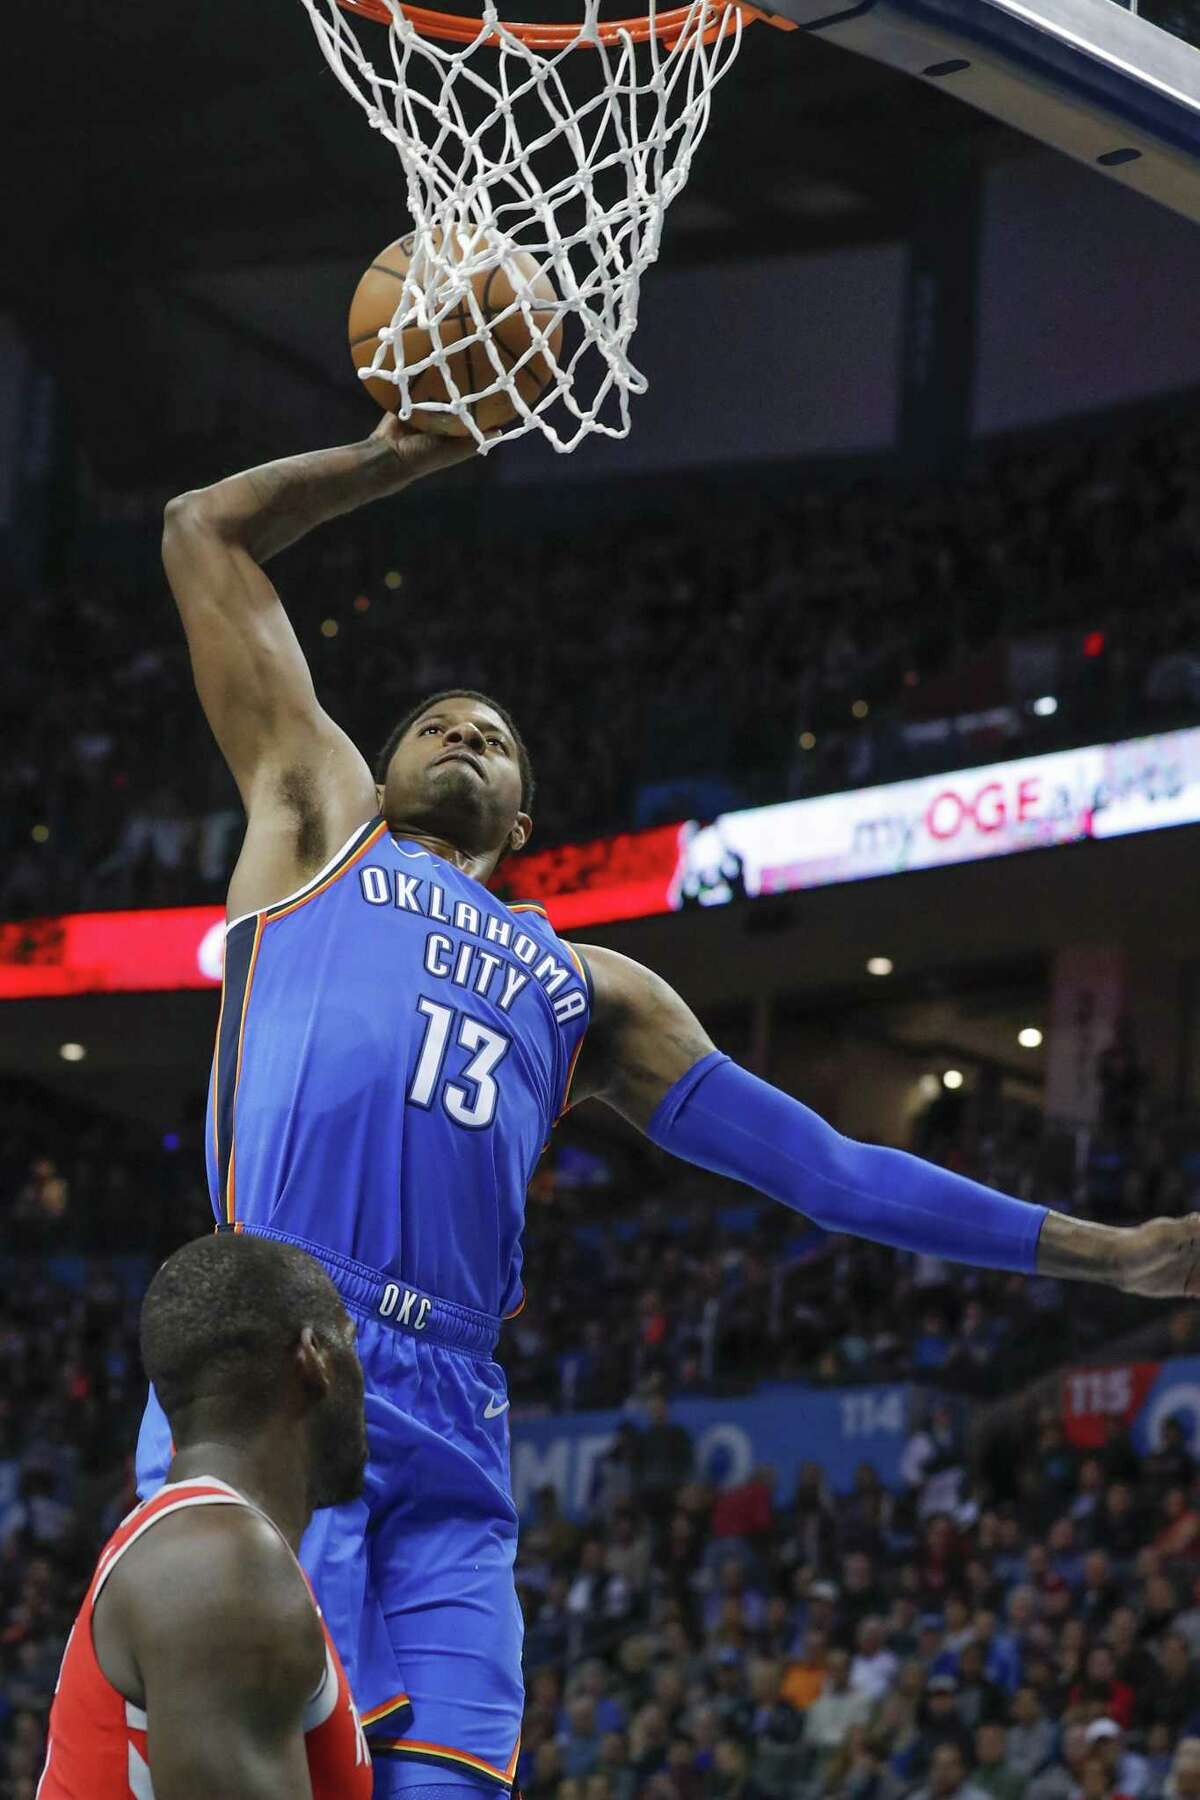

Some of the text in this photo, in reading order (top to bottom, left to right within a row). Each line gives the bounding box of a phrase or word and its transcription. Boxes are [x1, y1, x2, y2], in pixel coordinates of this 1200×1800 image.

[359, 865, 588, 1026] OKLAHOMA
[424, 931, 530, 1013] CITY
[408, 994, 512, 1130] 13
[379, 1283, 432, 1330] OKC
